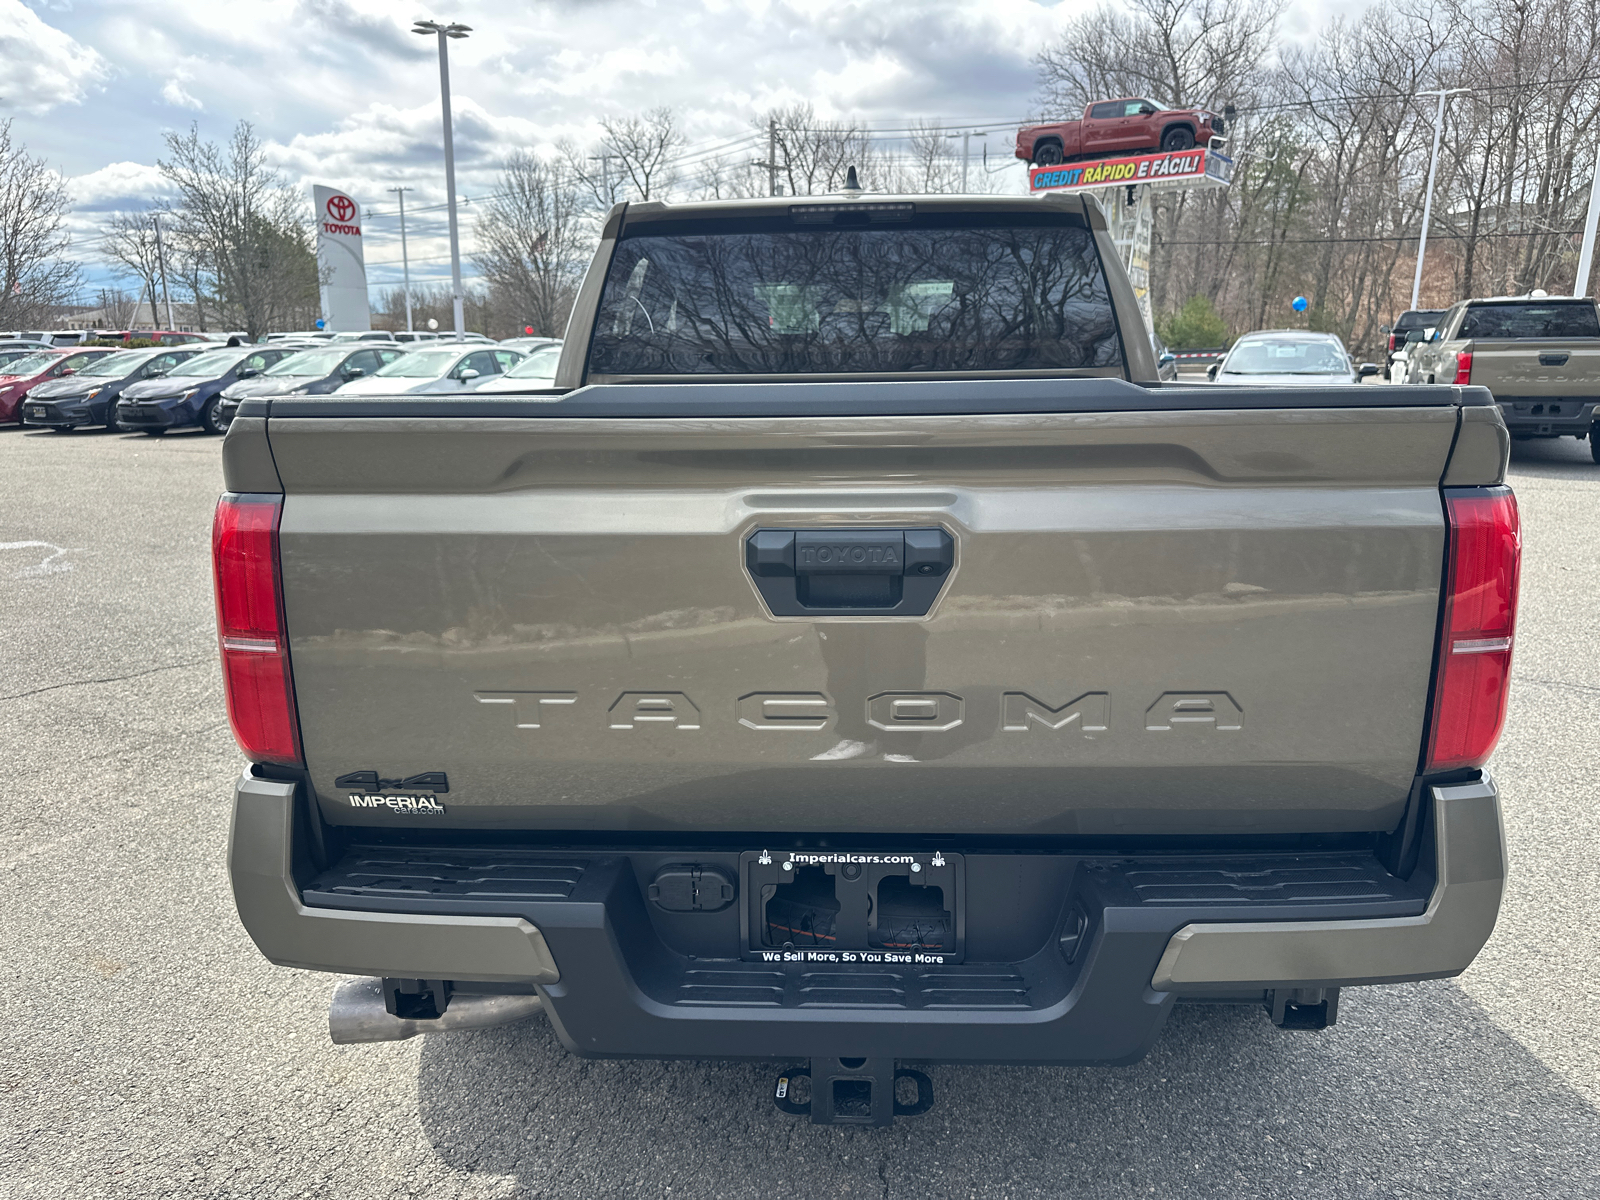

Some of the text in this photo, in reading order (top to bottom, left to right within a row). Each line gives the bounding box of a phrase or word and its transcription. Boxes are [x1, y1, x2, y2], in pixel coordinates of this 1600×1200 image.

[1034, 154, 1200, 189] CREDIT RÁPIDO E FÁCIL!
[323, 222, 361, 236] TOYOTA
[801, 546, 899, 563] TOYOTA
[474, 690, 1245, 731] TACOMA
[348, 794, 444, 809] IMPERIAL
[393, 807, 445, 815] cars.com
[789, 852, 915, 864] Imperialcars.com
[762, 952, 944, 964] We Sell More, So You Save More
